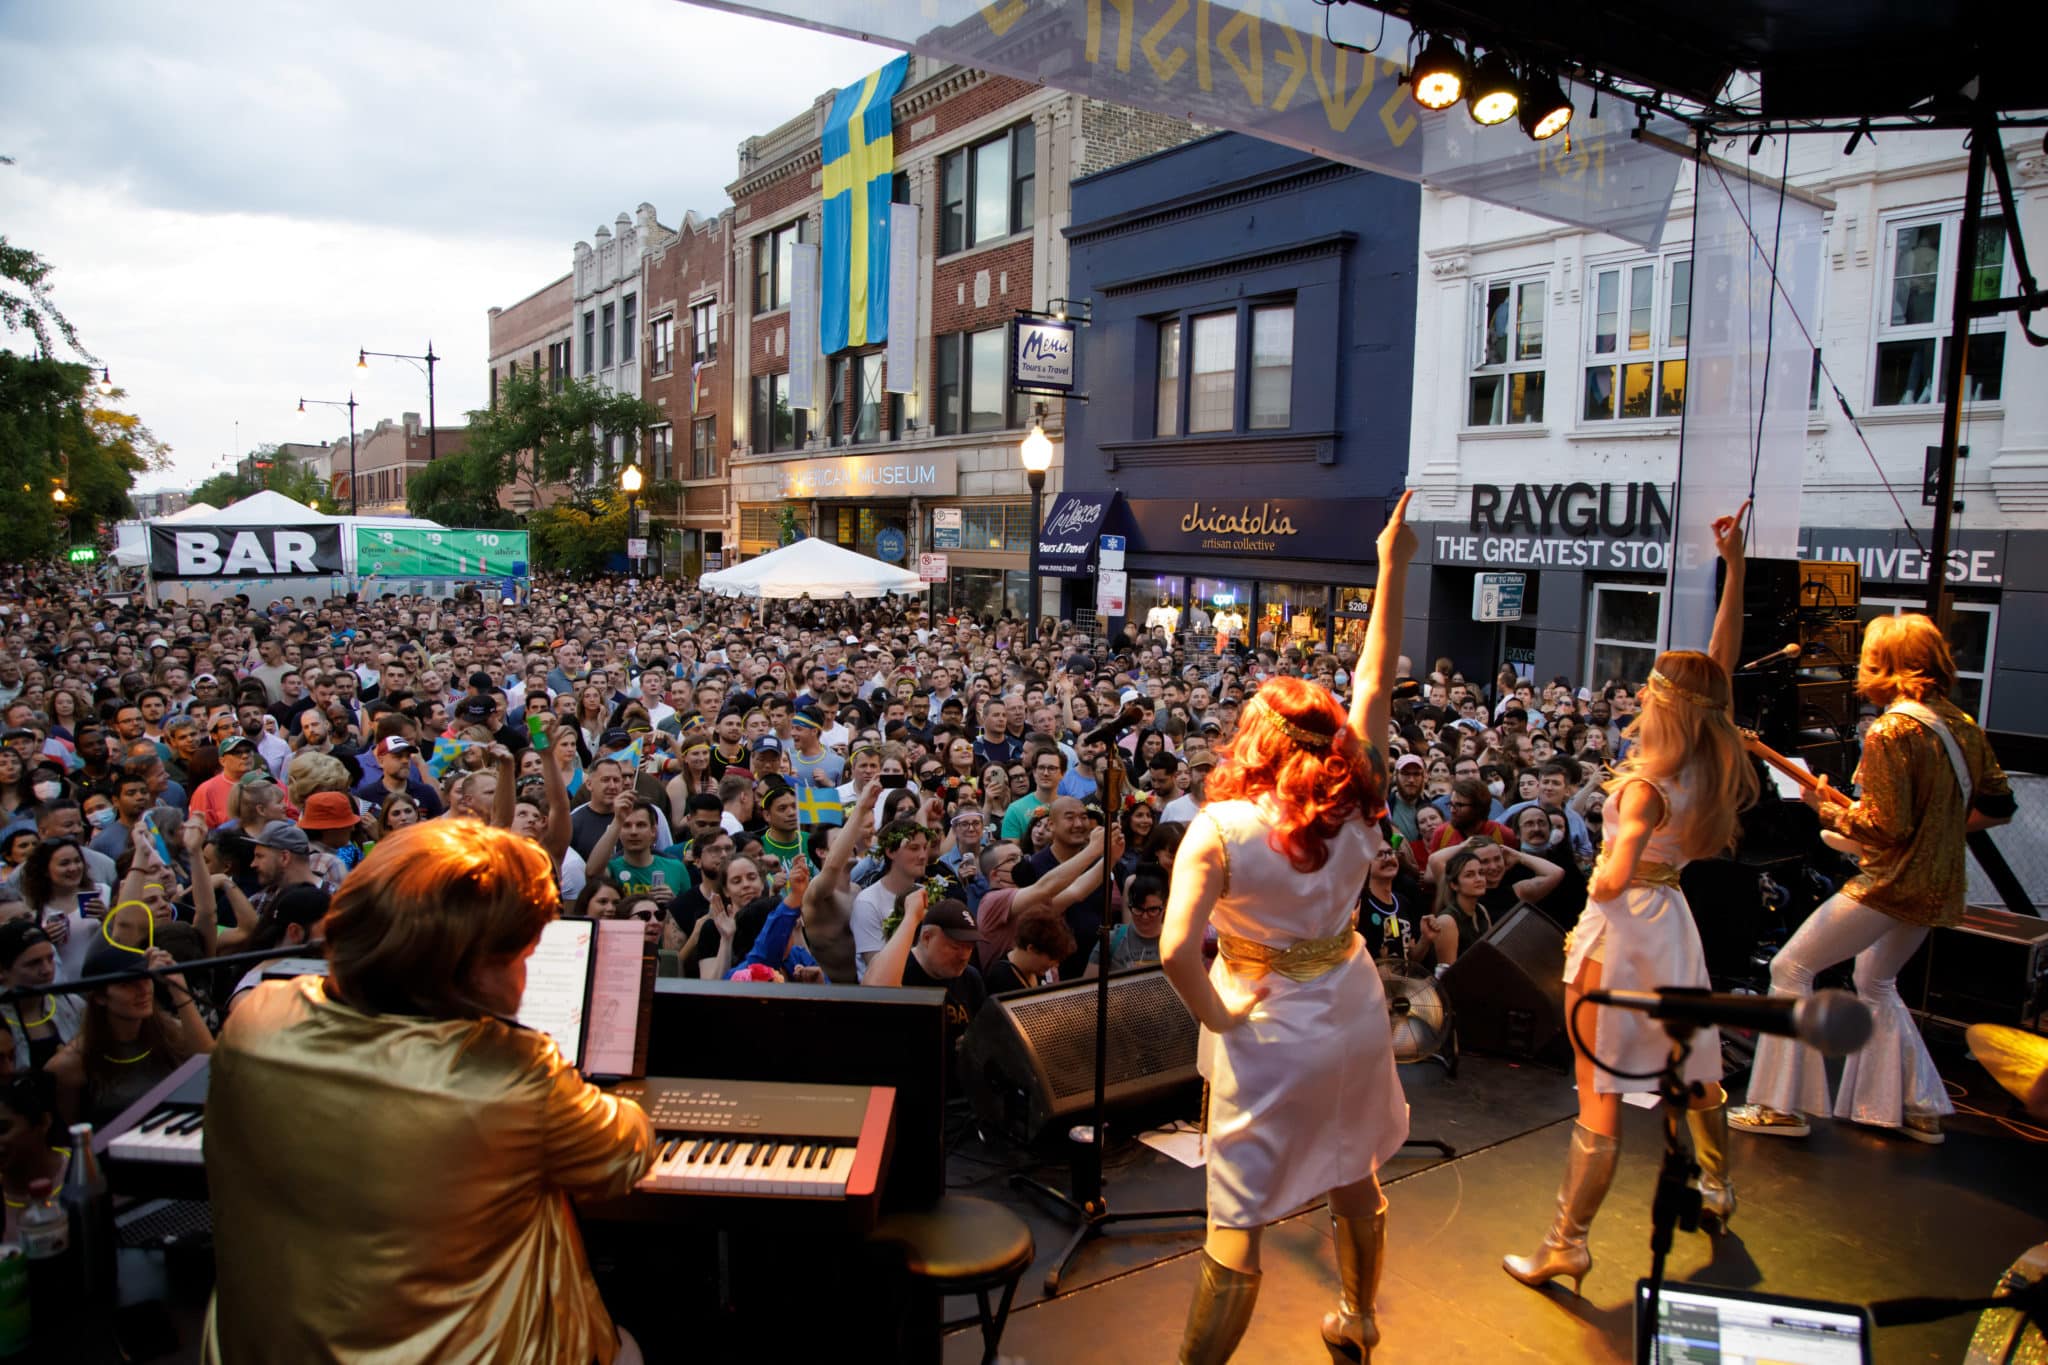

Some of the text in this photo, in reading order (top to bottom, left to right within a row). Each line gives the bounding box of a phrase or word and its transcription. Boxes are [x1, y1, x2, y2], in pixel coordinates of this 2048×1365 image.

[1022, 362, 1041, 372] Tours
[1047, 365, 1069, 376] Travel
[857, 464, 936, 487] MUSEUM
[1470, 481, 1677, 538] RAYGUN
[1181, 501, 1299, 535] chicatolia
[1062, 543, 1089, 553] Travel
[1201, 537, 1276, 552] artisan collective
[1436, 535, 1479, 562] THE
[1482, 536, 1605, 567] GREATEST
[71, 549, 95, 562] ATM
[175, 530, 320, 576] BAR
[1485, 575, 1523, 585] PAY TO PARK
[1348, 601, 1368, 614] 5209
